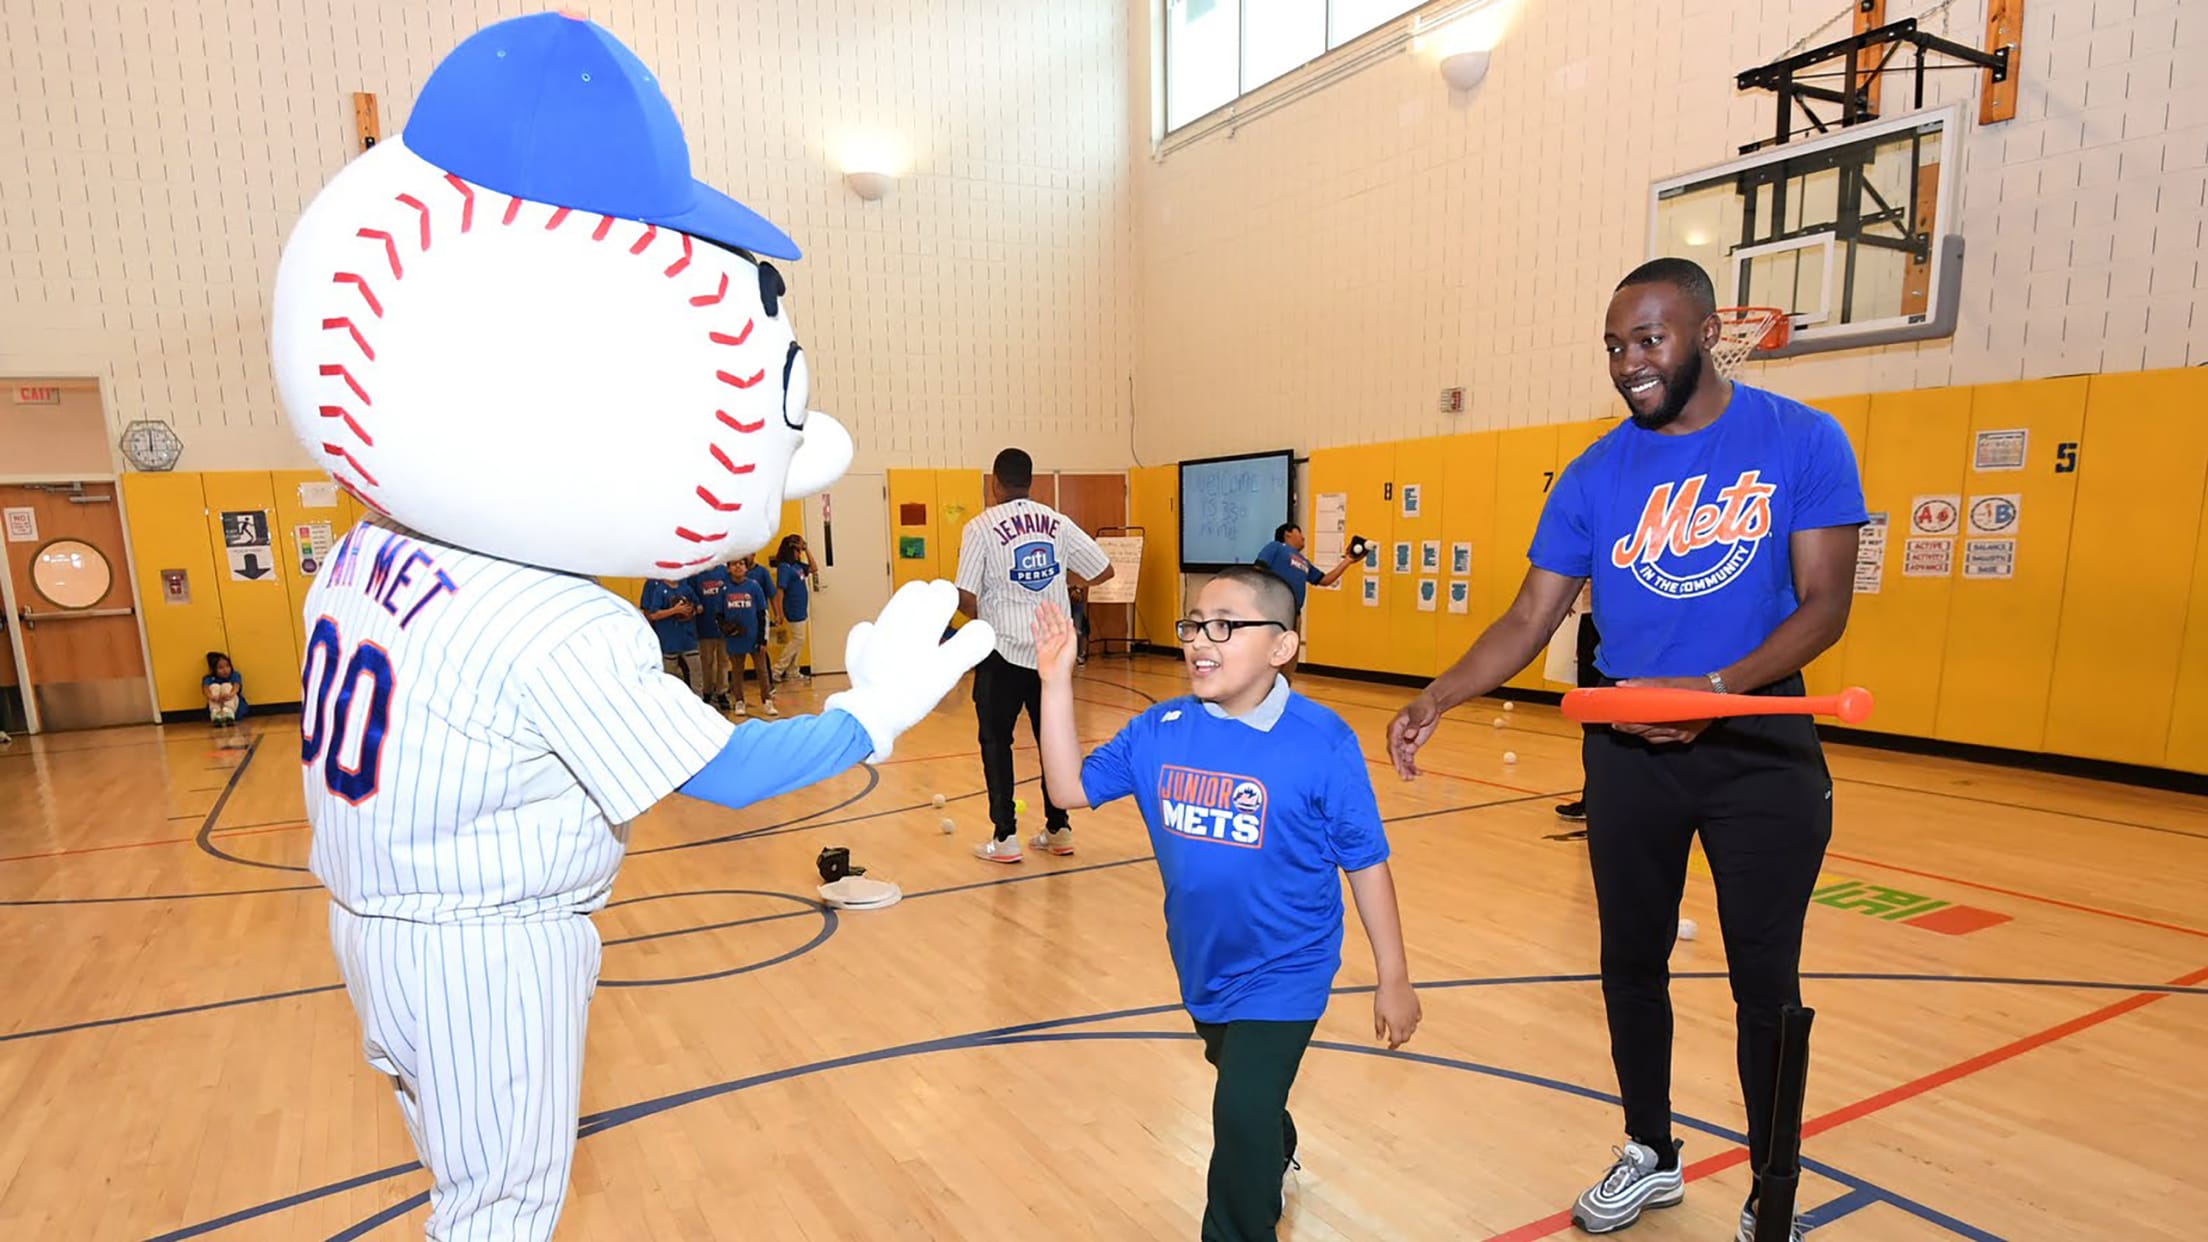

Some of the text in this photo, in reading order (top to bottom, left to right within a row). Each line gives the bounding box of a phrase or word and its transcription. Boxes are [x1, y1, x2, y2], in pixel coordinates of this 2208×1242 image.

[2055, 442, 2077, 473] 5
[1384, 482, 1392, 500] 8
[1543, 472, 1555, 493] 7
[993, 512, 1060, 546] JEMAINE
[1612, 470, 1776, 568] Mets
[1918, 506, 1933, 523] A
[1995, 504, 2012, 523] B
[1017, 566, 1055, 580] PERKS
[1022, 551, 1047, 569] citi
[1640, 545, 1750, 593] IN THE COMMUNITY
[365, 532, 460, 630] MET
[727, 600, 752, 609] METS
[301, 614, 397, 806] 00
[1161, 770, 1234, 810] JUNIOR
[1162, 799, 1260, 844] METS
